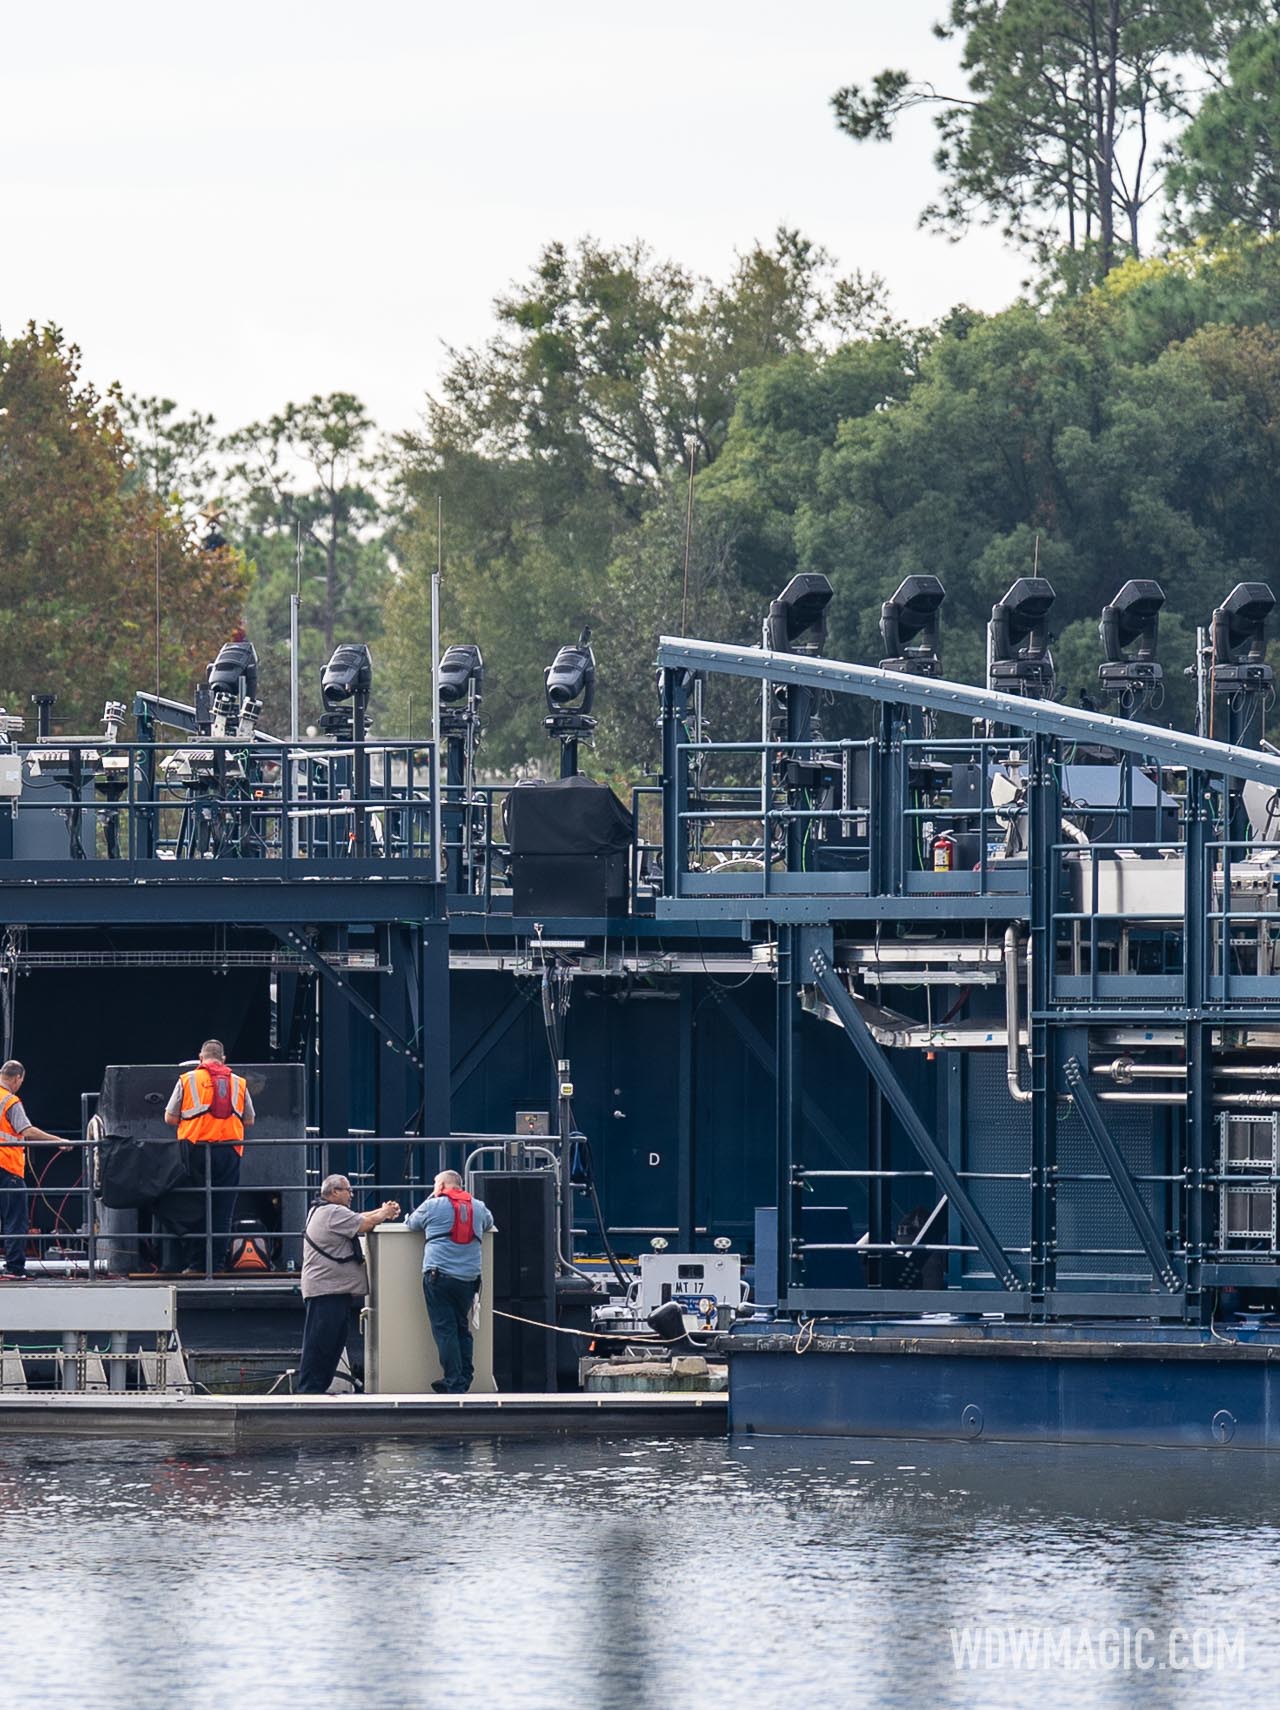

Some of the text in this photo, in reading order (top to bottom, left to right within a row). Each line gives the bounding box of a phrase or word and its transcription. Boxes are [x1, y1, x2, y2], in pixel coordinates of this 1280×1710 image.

[649, 1152, 660, 1166] D
[675, 1281, 704, 1294] MT 17
